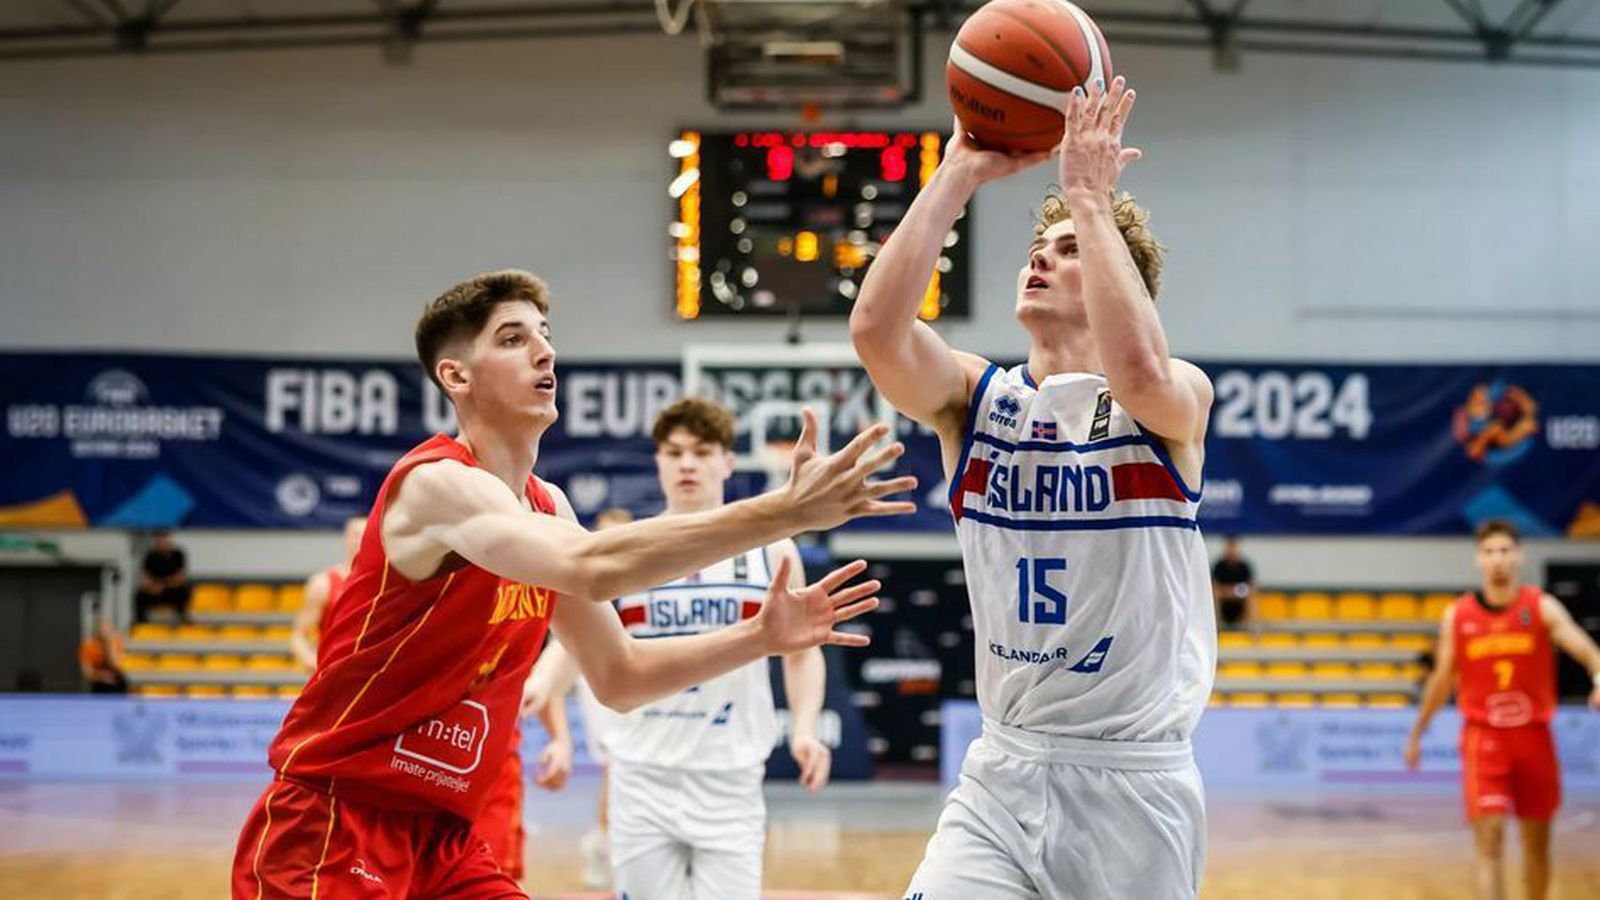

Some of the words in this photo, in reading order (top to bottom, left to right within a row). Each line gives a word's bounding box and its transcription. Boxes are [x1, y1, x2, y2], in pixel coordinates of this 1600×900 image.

[266, 369, 399, 434] FIBA
[1214, 371, 1373, 439] 2024
[1016, 557, 1067, 625] 15
